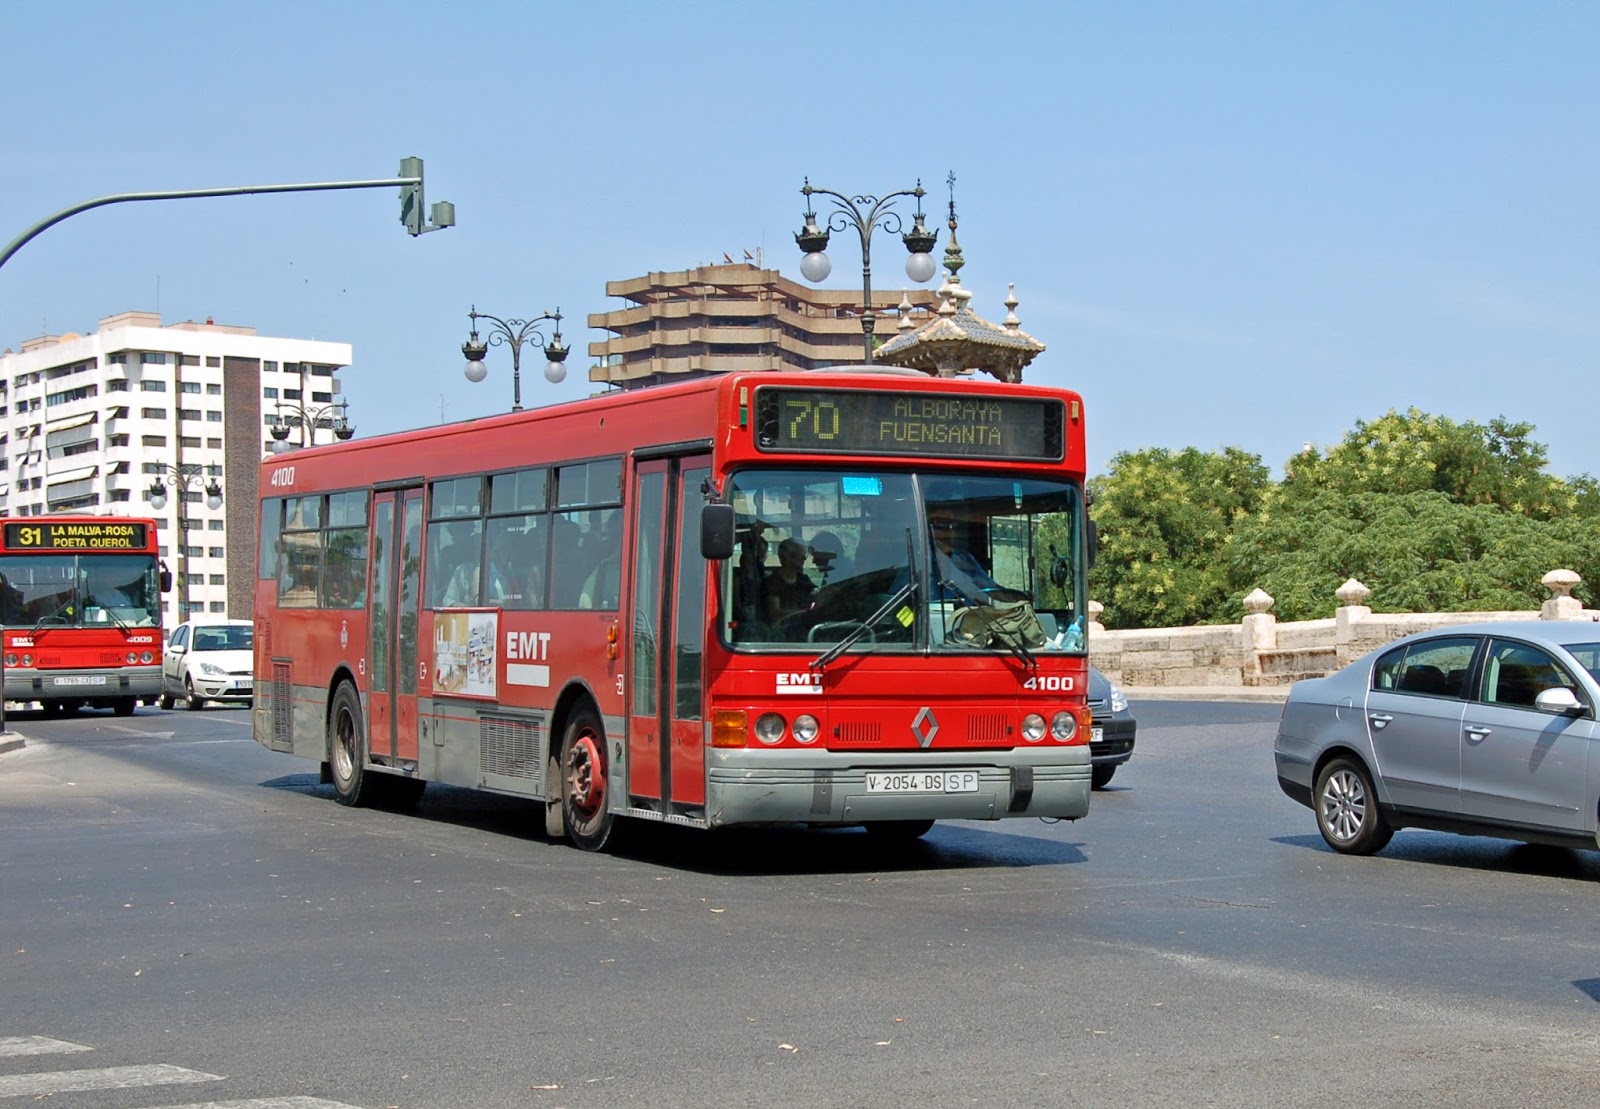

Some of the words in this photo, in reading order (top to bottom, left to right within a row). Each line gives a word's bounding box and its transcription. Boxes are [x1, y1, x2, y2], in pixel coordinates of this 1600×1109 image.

[785, 400, 840, 440] 70
[893, 399, 1002, 422] ALBORAYA
[879, 420, 1001, 446] FUENSANTA
[271, 466, 296, 487] 4100
[19, 527, 42, 545] 31
[51, 526, 66, 536] LA
[67, 526, 134, 536] MALVA-ROSA
[53, 537, 88, 548] POETA
[89, 537, 132, 547] QUEROL
[506, 632, 551, 661] EMT
[775, 673, 824, 685] EMT
[1023, 676, 1074, 691] 4100
